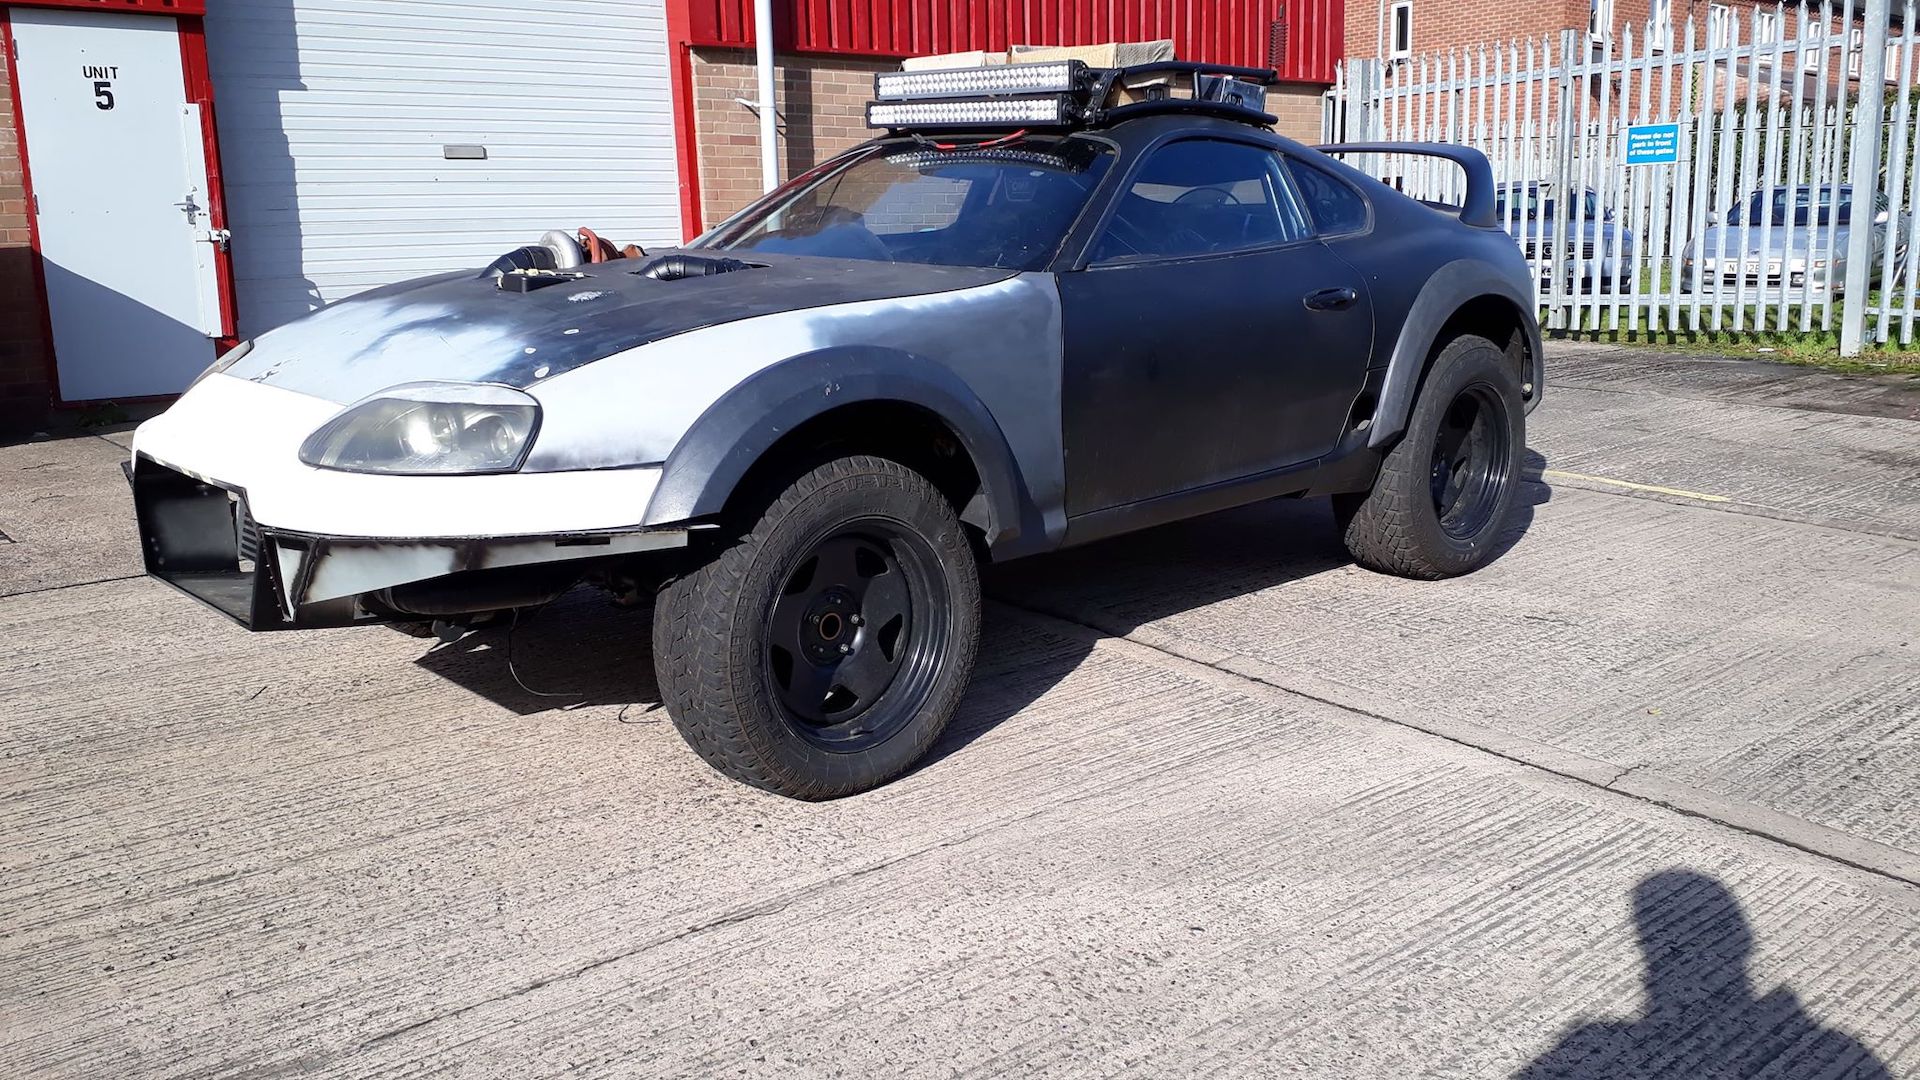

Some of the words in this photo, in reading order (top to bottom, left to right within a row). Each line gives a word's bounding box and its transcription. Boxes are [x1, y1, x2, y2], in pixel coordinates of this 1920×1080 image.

[82, 65, 119, 79] UNIT
[93, 81, 115, 110] 5
[1632, 141, 1647, 149] park
[1655, 148, 1674, 156] gates
